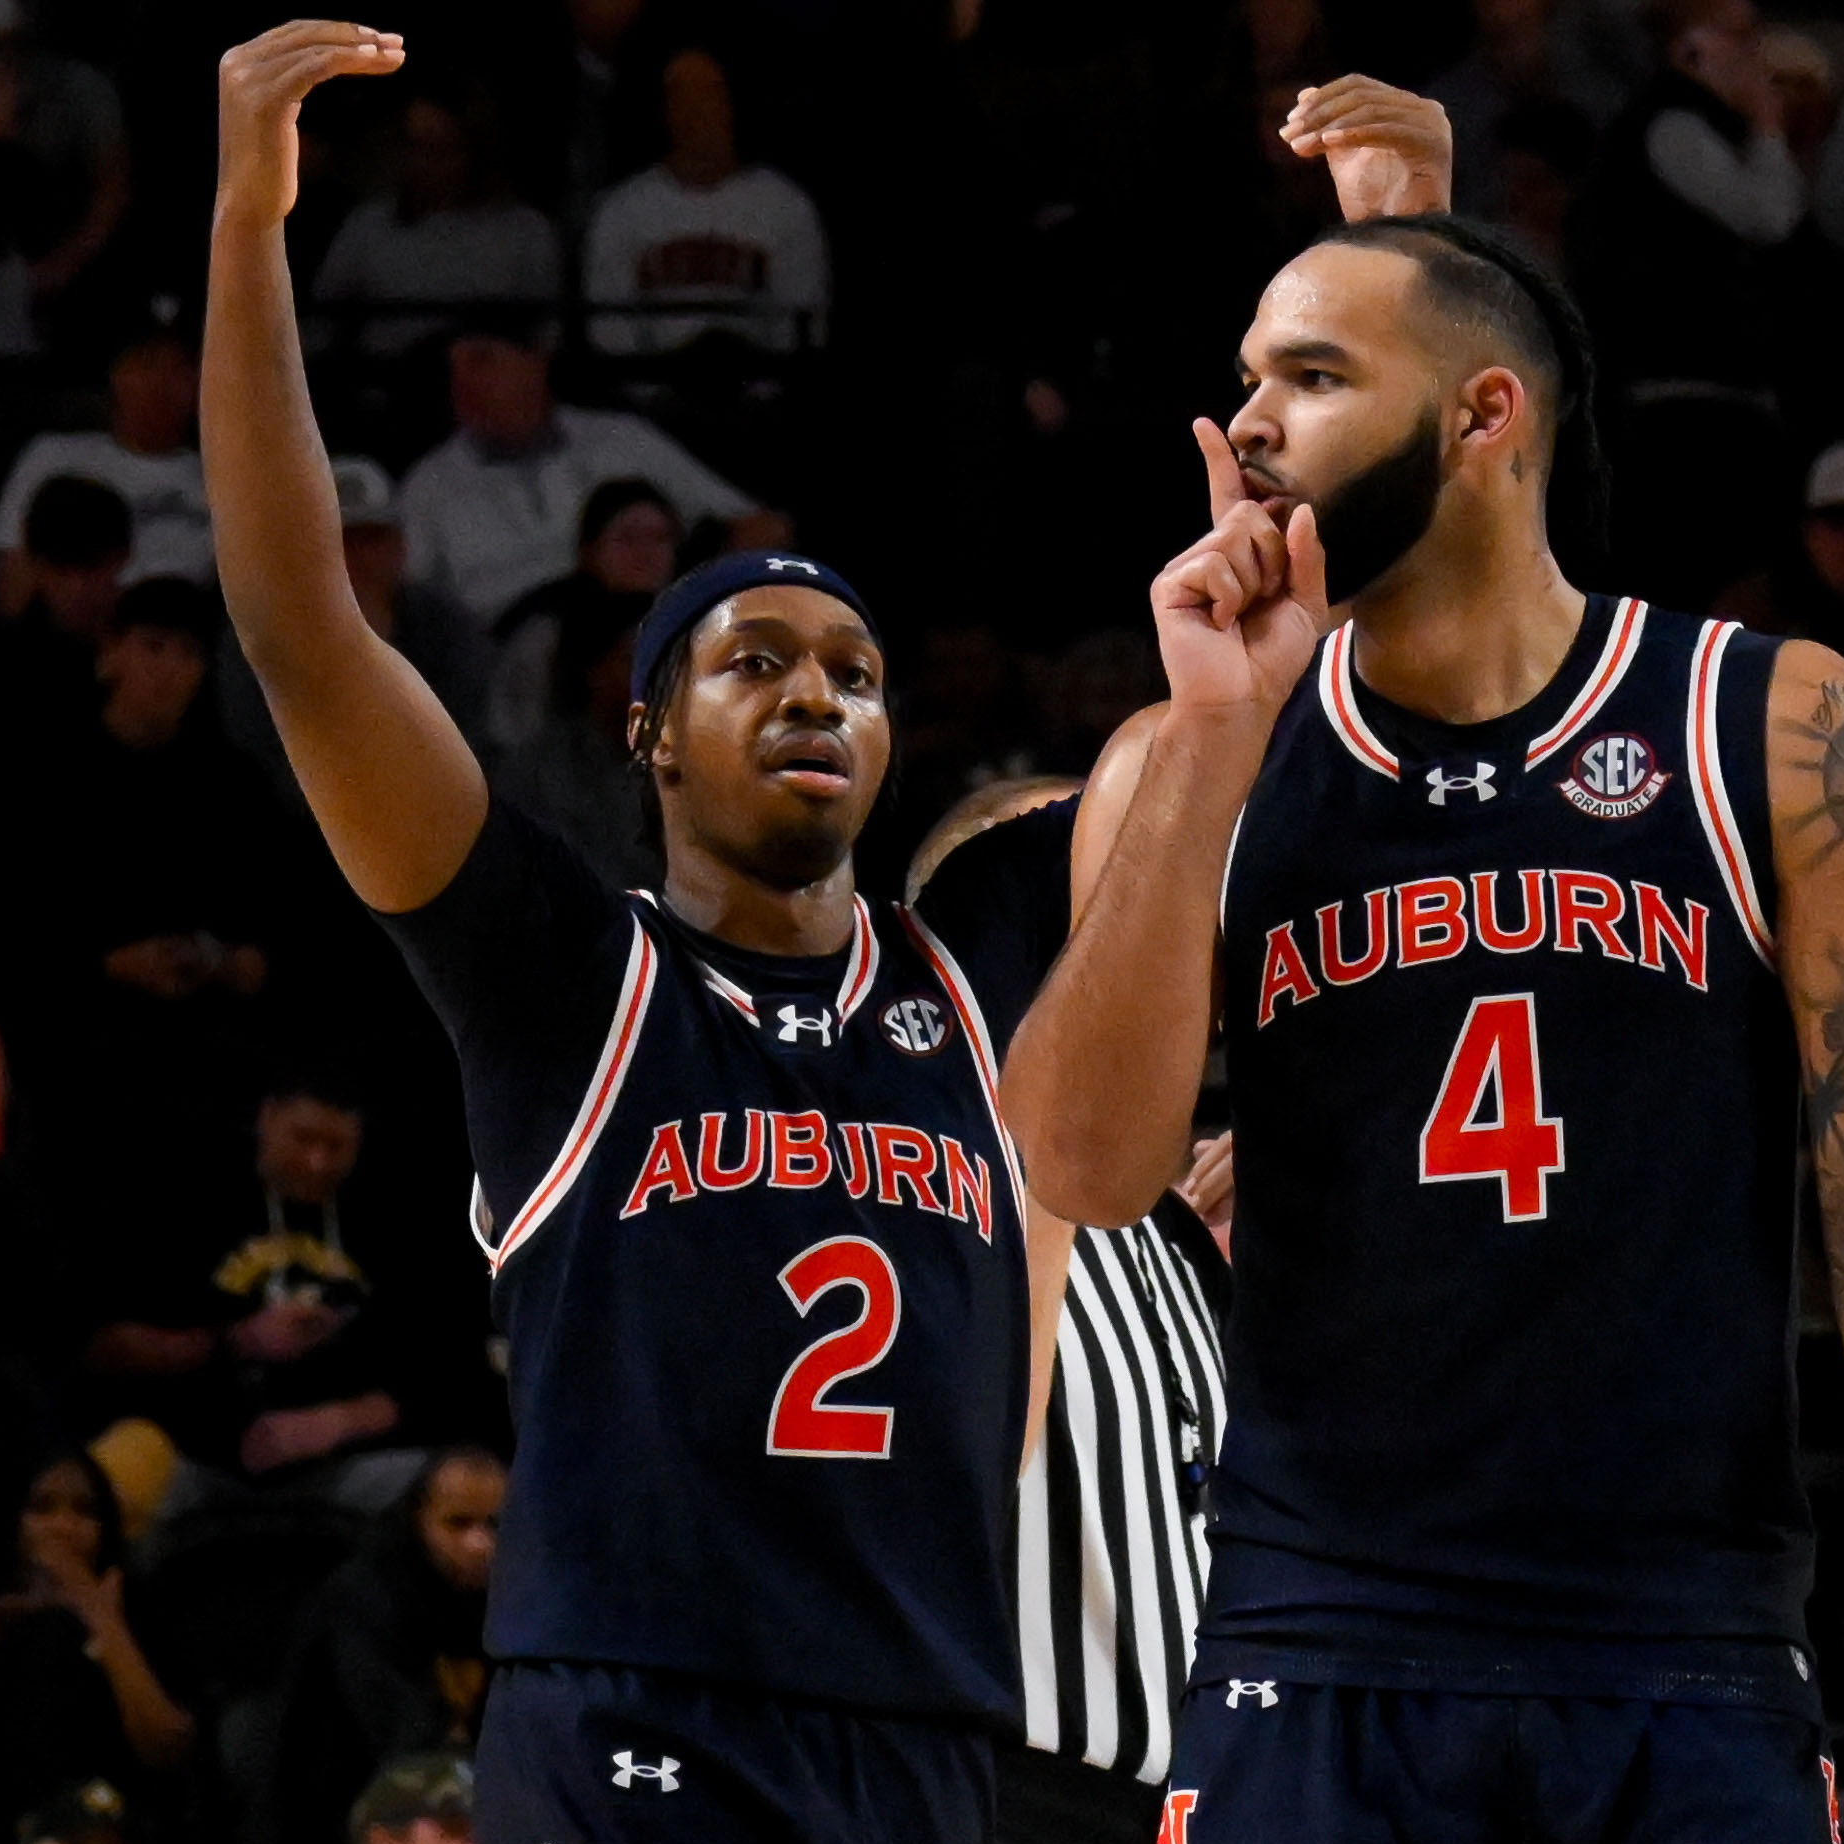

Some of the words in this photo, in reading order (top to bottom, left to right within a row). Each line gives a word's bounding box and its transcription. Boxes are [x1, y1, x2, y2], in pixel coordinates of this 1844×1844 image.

[1572, 788, 1655, 817] GRADUATE
[1581, 737, 1647, 795] SEC
[1257, 869, 1709, 1030] AUBURN
[883, 998, 946, 1051] SEC
[619, 1107, 992, 1247] AUBURN
[1419, 992, 1565, 1223] 4
[766, 1235, 901, 1459] 2
